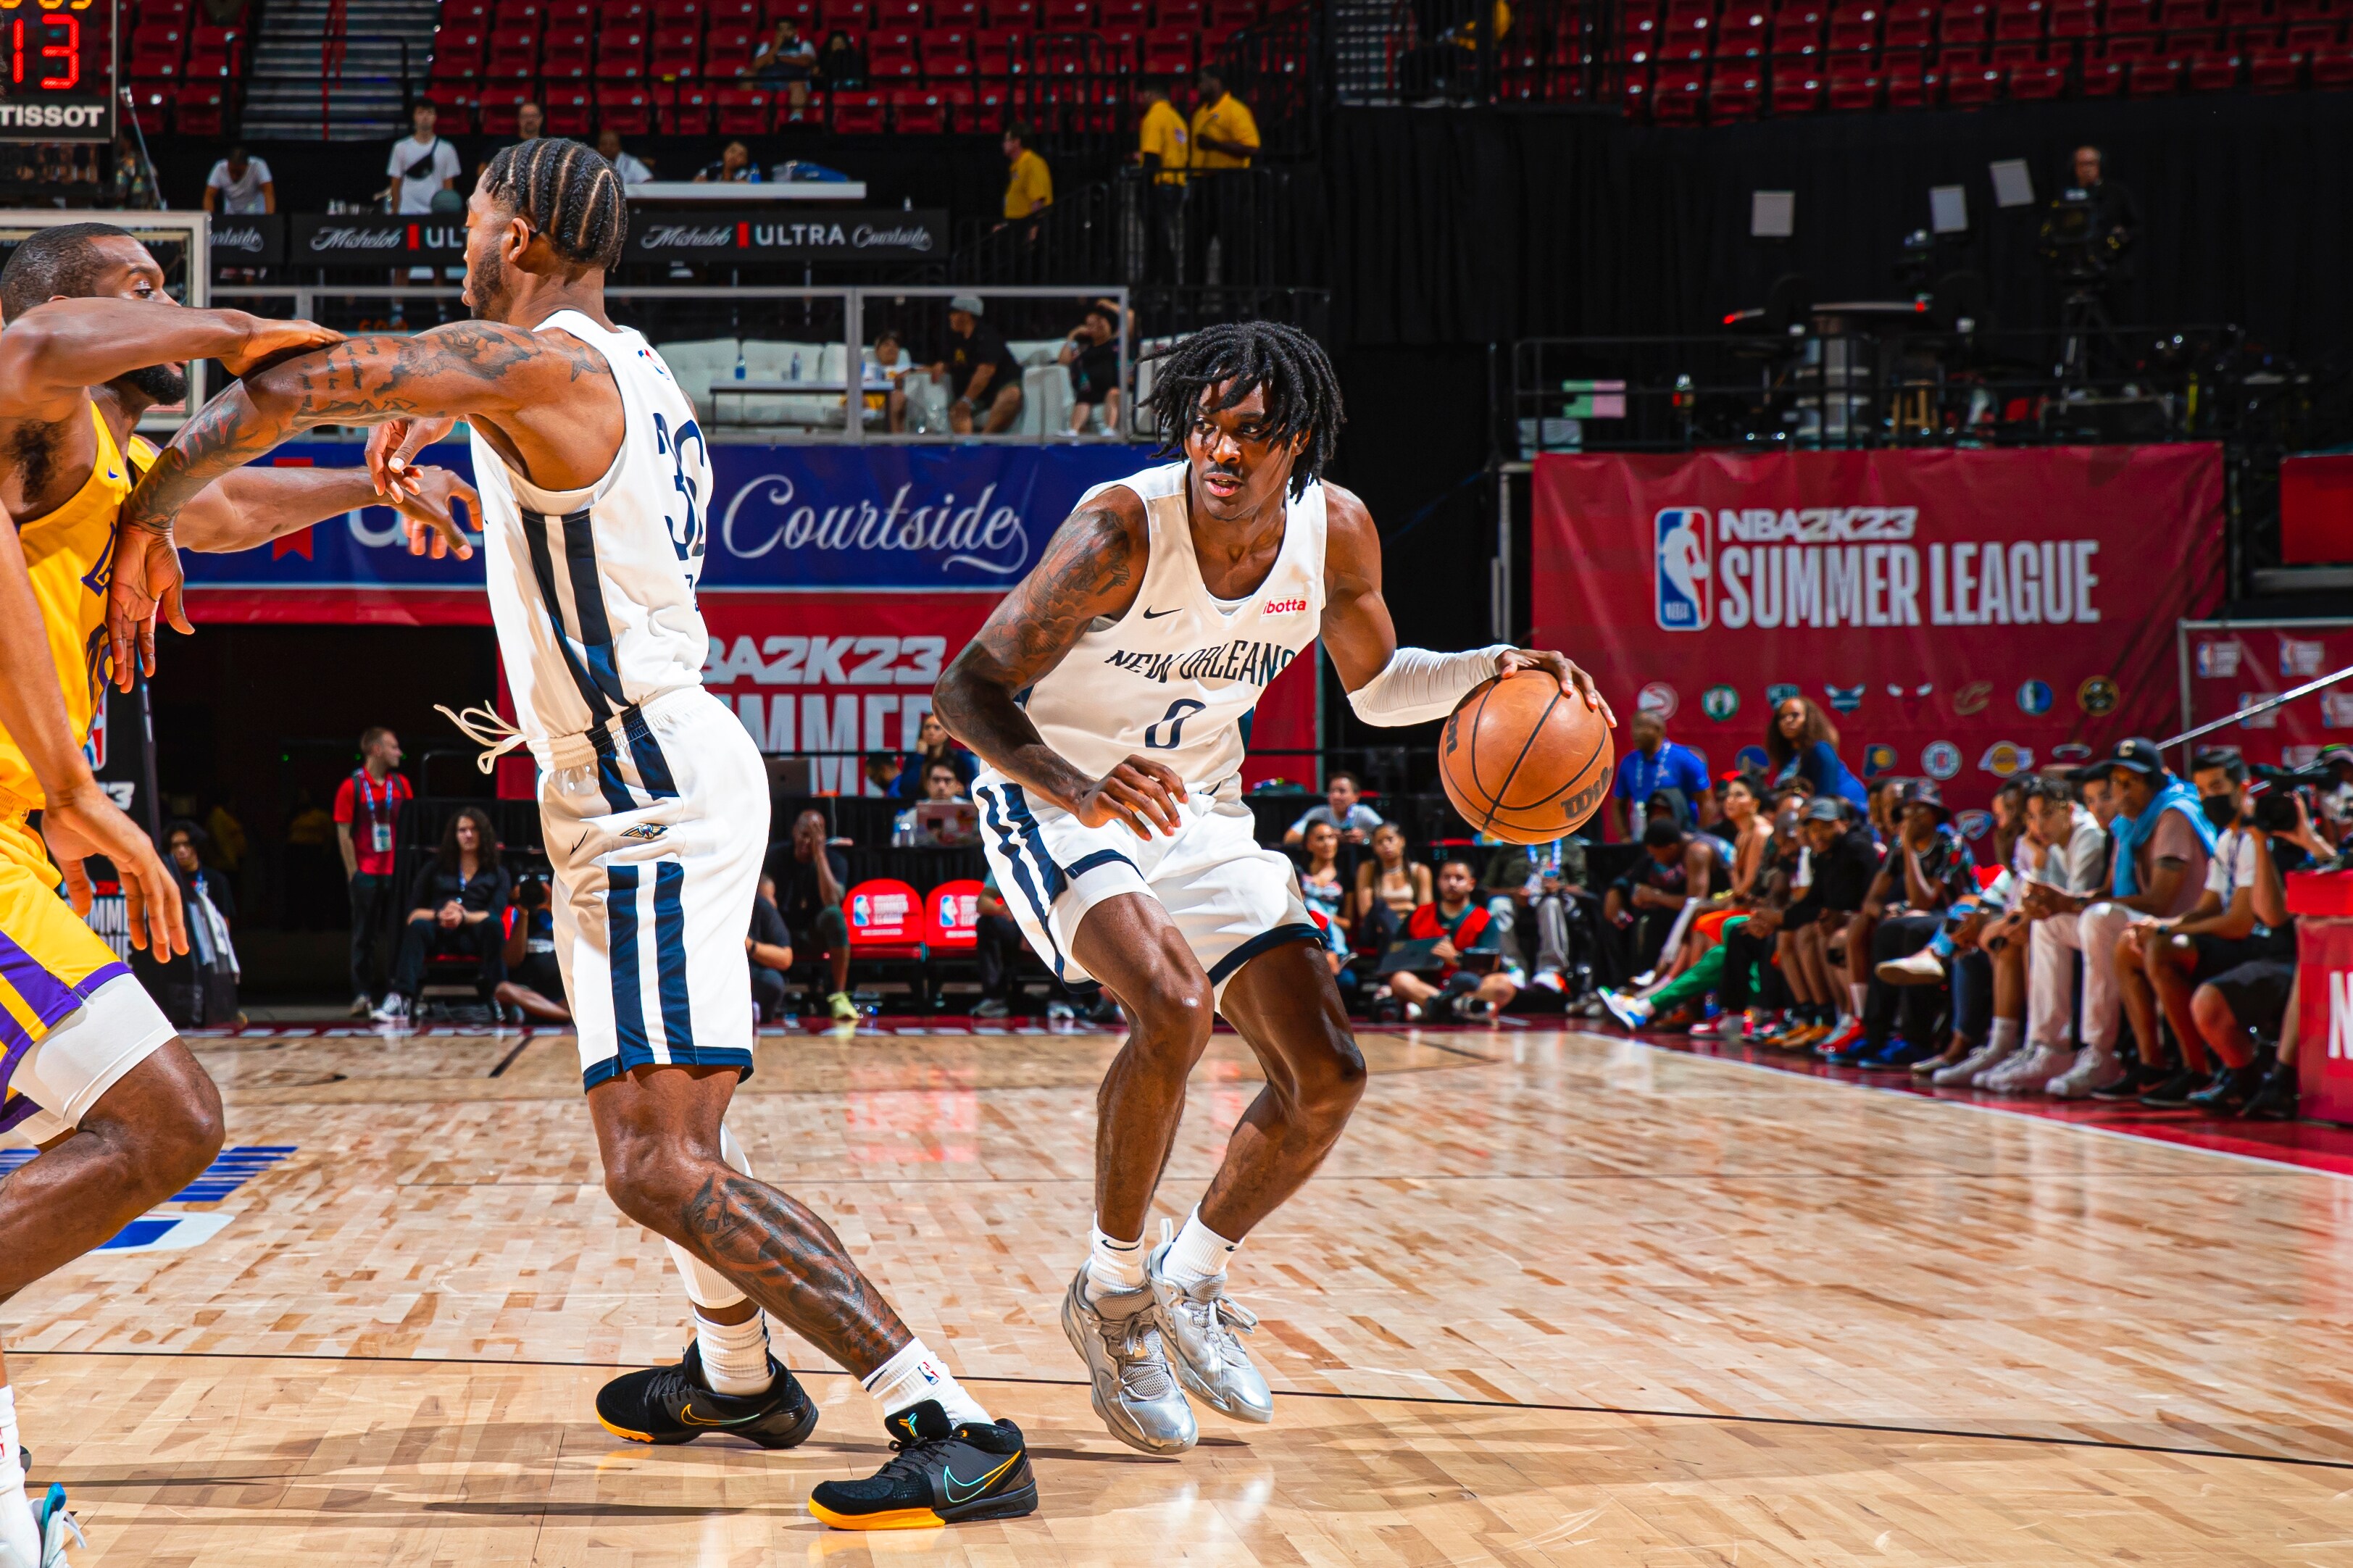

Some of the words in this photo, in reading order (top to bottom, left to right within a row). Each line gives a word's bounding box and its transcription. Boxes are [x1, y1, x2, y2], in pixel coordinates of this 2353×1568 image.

[13, 14, 79, 89] 13
[0, 104, 104, 127] TISSOT
[310, 226, 401, 251] Michelob
[641, 225, 732, 249] Michelob
[755, 224, 846, 246] ULTRA
[722, 474, 1028, 574] Courtside
[1718, 506, 1918, 542] NBA2K23
[1718, 544, 1920, 628] SUMMER
[1928, 540, 2101, 625] LEAGUE
[1263, 599, 1307, 614] ibotta
[701, 635, 947, 685] BA2K23
[1104, 649, 1185, 683] NEW
[1145, 698, 1206, 749] 0
